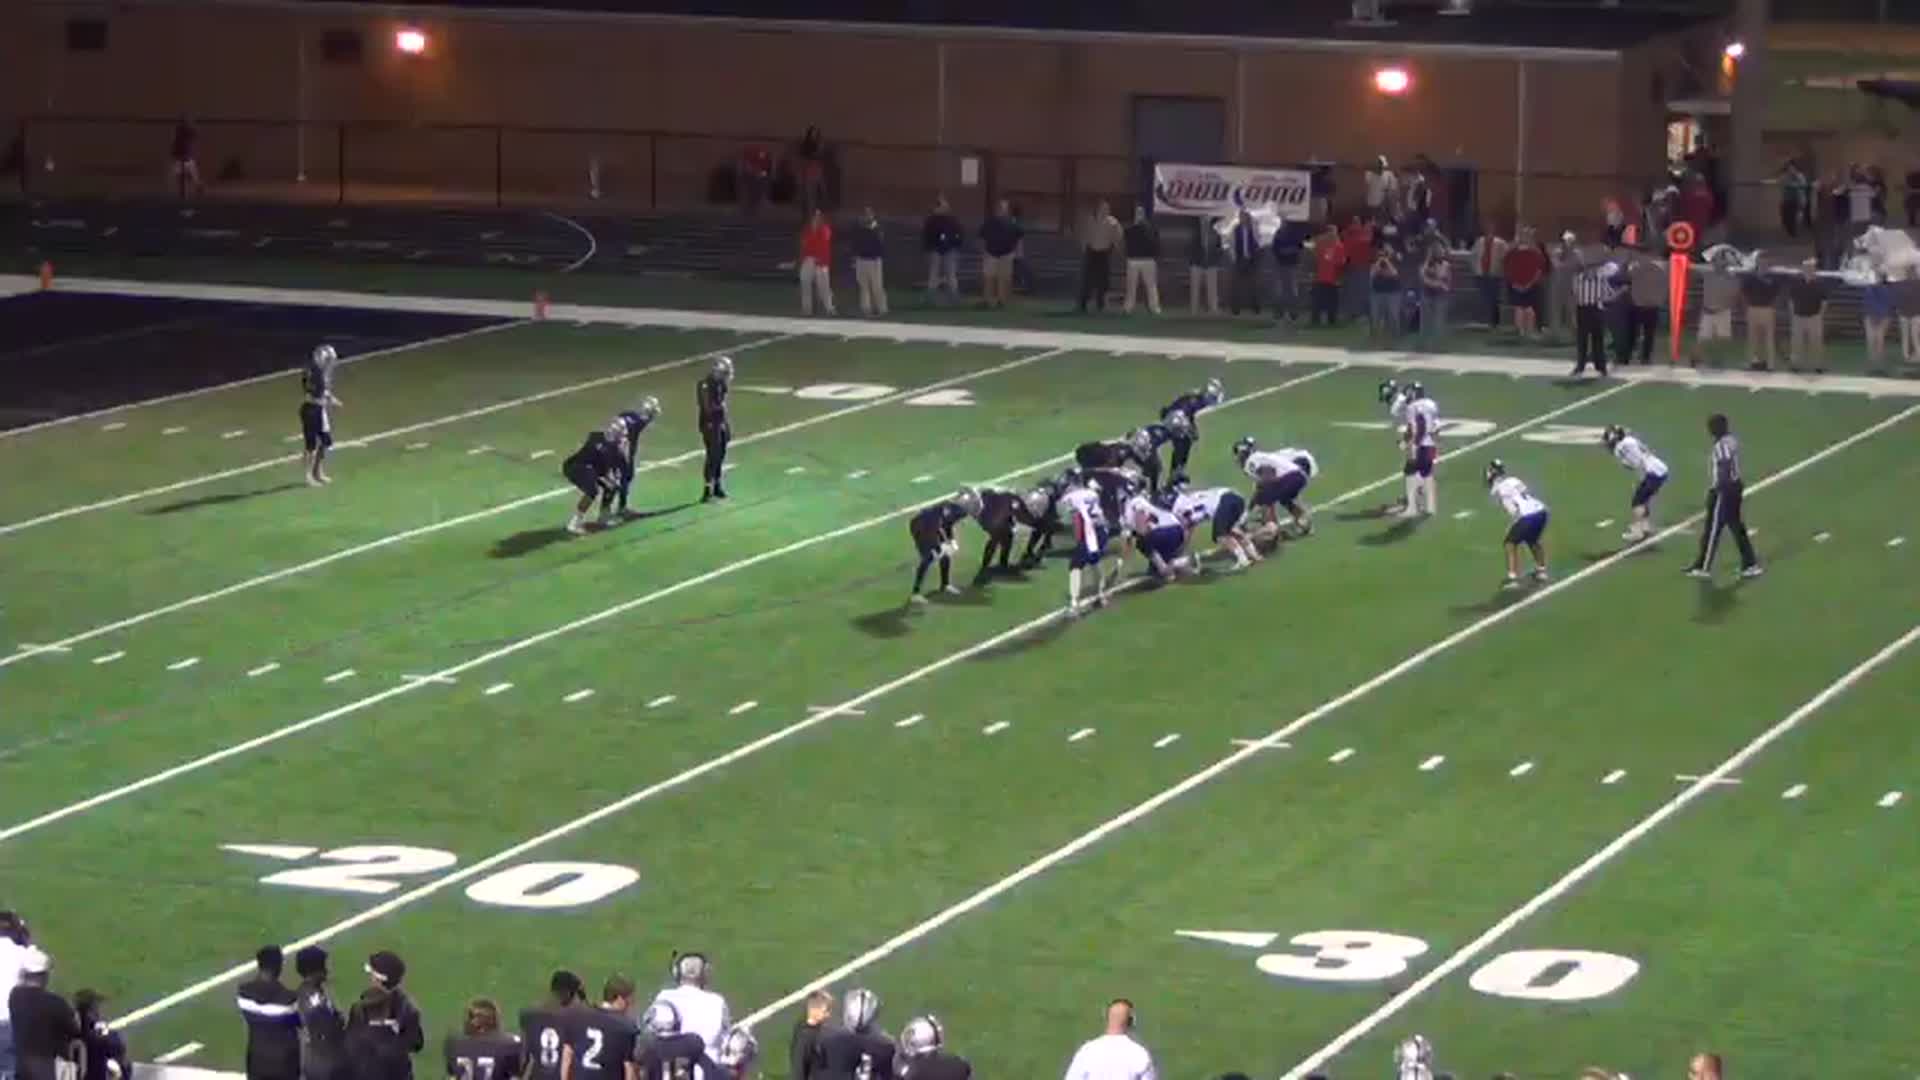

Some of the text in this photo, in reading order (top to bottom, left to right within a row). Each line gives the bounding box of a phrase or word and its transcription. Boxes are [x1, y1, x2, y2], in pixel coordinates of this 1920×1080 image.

[259, 845, 640, 907] 20
[1255, 930, 1640, 1000] 30
[582, 1027, 603, 1069] 2
